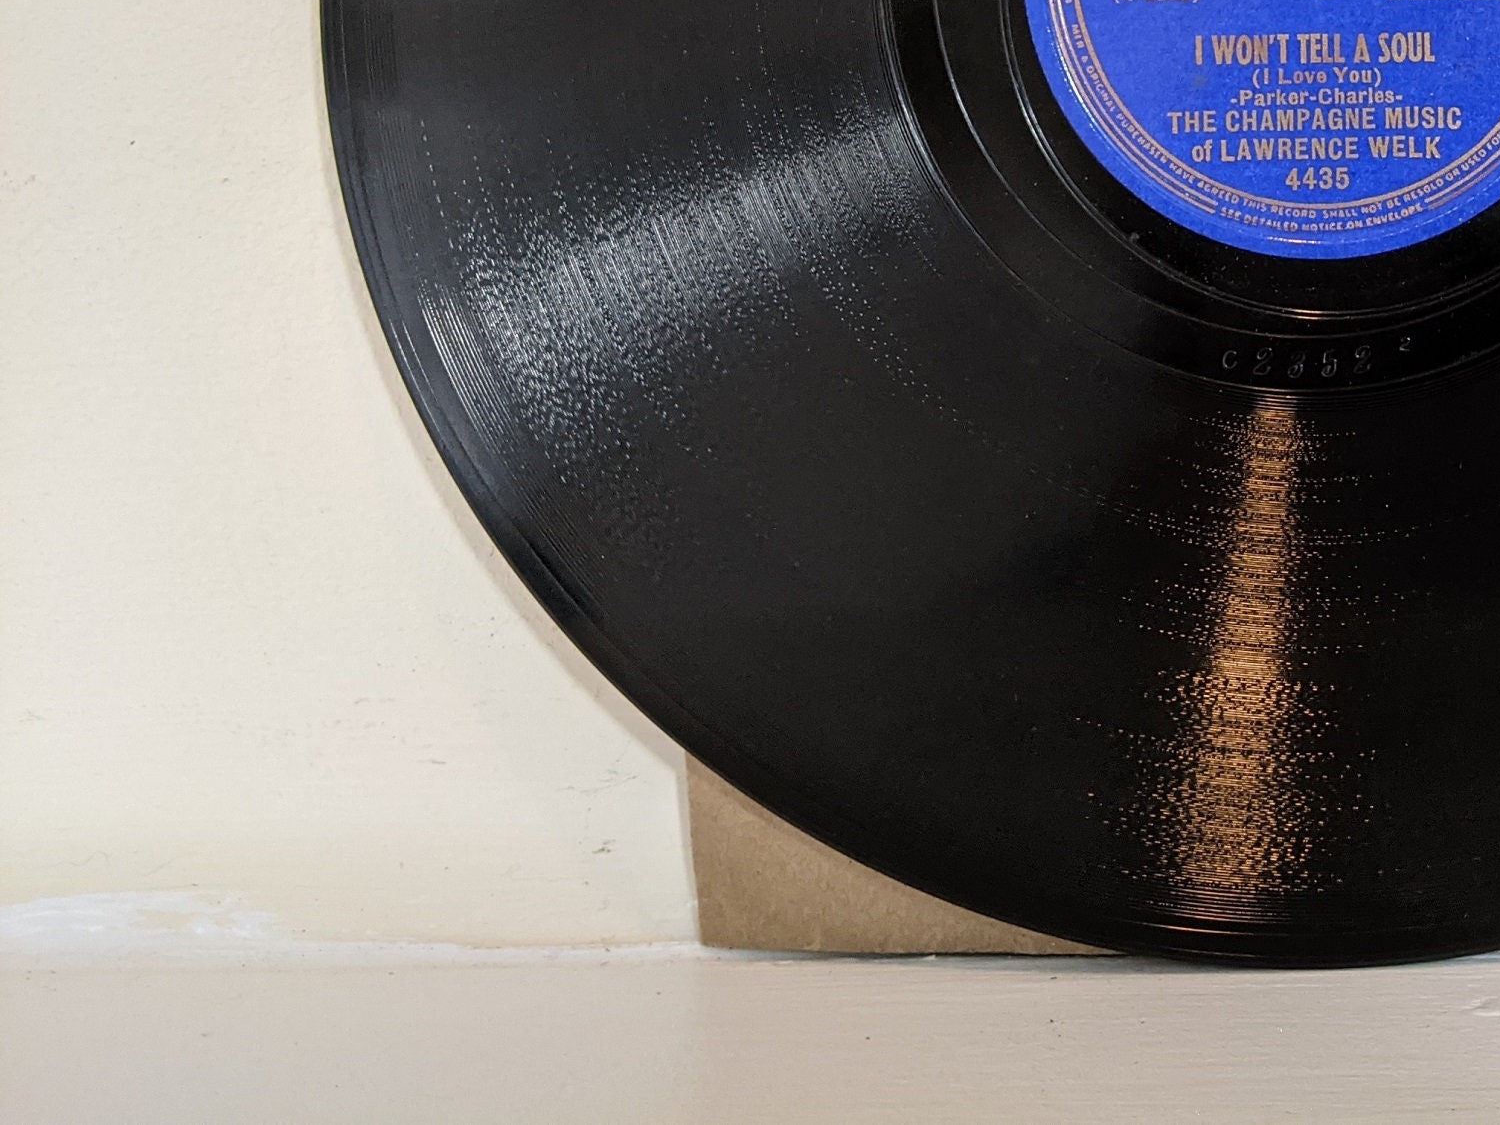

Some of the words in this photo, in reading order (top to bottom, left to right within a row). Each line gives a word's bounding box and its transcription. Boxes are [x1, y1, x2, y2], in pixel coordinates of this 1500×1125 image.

[1194, 35, 1203, 65] I
[1211, 33, 1289, 65] WON'T
[1297, 32, 1345, 64] TELL
[1354, 32, 1370, 63] A
[1378, 32, 1436, 63] SOUL
[1252, 68, 1269, 89] (I
[1278, 68, 1328, 85] Love
[1332, 66, 1382, 88] You)
[1167, 111, 1217, 134] THE
[1225, 106, 1376, 133] CHAMPAGNE
[1384, 106, 1462, 130] MUSIC
[1086, 65, 1117, 113] ORIGINAL
[1116, 113, 1168, 164] PURCHASER
[1169, 162, 1196, 184] HAVE
[1197, 180, 1239, 205] AGREED
[1242, 198, 1267, 213] THIS
[1270, 204, 1317, 219] RECORD
[1322, 208, 1358, 219] SHALL
[1361, 202, 1383, 215] NOT
[1386, 197, 1401, 209] BE
[1403, 178, 1444, 203] RESOLD
[1445, 168, 1461, 181] OR
[1461, 148, 1487, 172] USED
[1192, 139, 1213, 162] of
[1221, 137, 1359, 162] LAWRENCE
[1368, 136, 1441, 159] WELK
[1285, 167, 1350, 191] 4435
[1220, 207, 1241, 221] SEE
[1244, 212, 1298, 232] DETAILED
[1366, 203, 1423, 227] ENVELOPE
